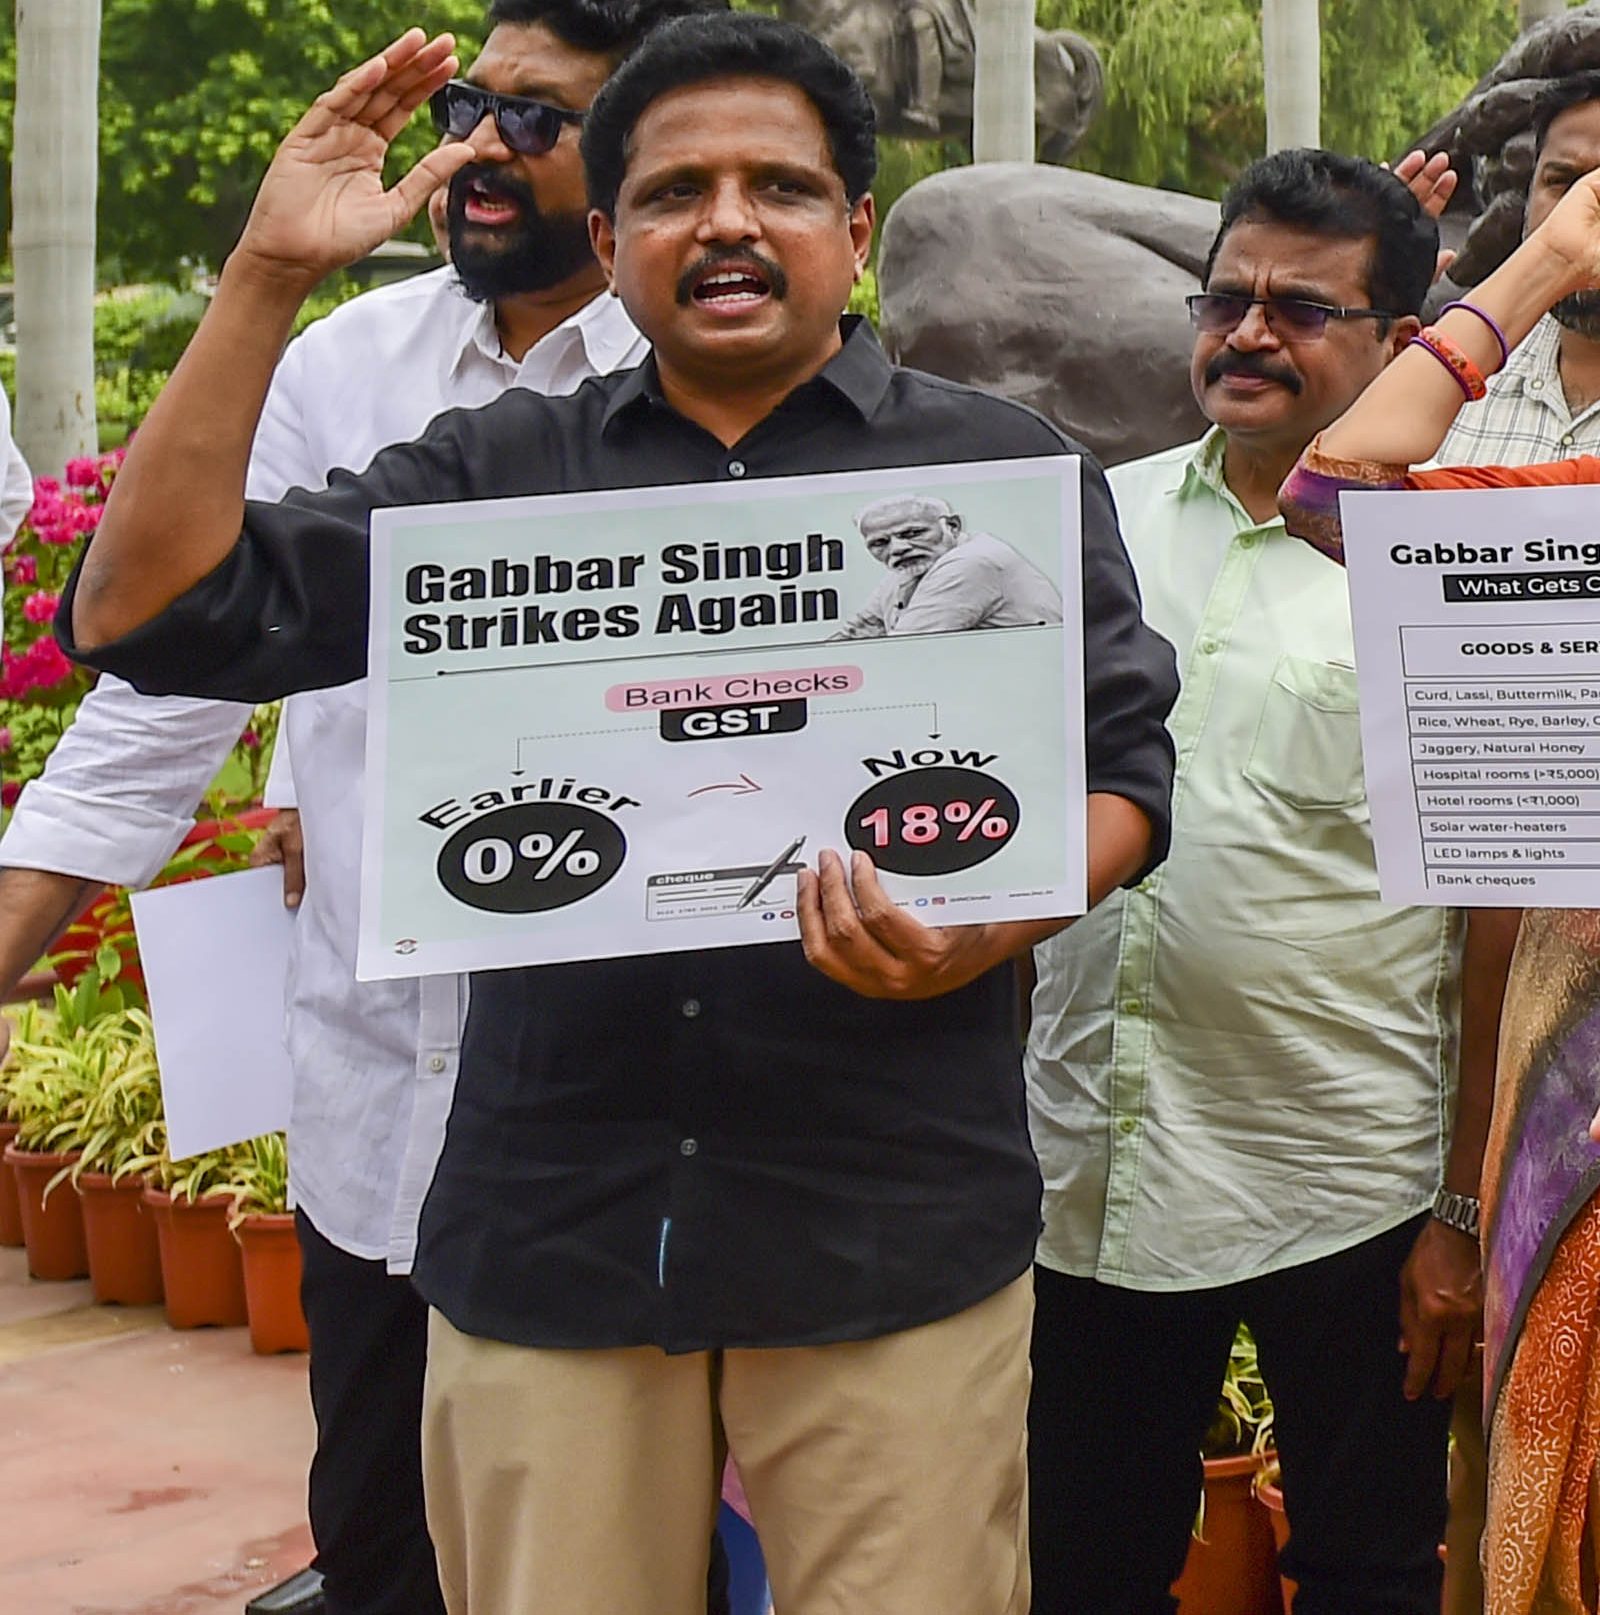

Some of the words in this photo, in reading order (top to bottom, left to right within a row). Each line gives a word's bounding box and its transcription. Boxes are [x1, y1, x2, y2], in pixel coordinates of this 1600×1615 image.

[1390, 543, 1513, 564] Gabbar
[404, 552, 645, 605] Gabbar
[661, 533, 844, 587] Singh
[1458, 578, 1522, 595] What
[1527, 577, 1580, 594] Gets
[403, 600, 639, 656] Strikes
[655, 583, 839, 635] Again
[1461, 642, 1534, 655] GOODS
[1540, 641, 1553, 654] &
[625, 683, 712, 708] Bank
[724, 670, 849, 699] Checks
[1415, 689, 1452, 703] Curd,
[1496, 688, 1577, 702] Buttermilk,
[681, 705, 780, 737] GST
[1418, 716, 1451, 729] Rice,
[1454, 716, 1505, 728] Wheat,
[1509, 716, 1538, 729] Rye,
[1542, 715, 1589, 728] Barley,
[1420, 742, 1480, 756] Jaggery,
[1484, 742, 1536, 753] Natural
[1539, 742, 1585, 755] Honey
[861, 747, 1000, 778] Now
[1423, 768, 1481, 782] Hospital
[1485, 770, 1530, 780] rooms
[419, 778, 641, 831] Earlier
[1427, 795, 1464, 806] Hotel
[1468, 796, 1513, 806] rooms
[859, 798, 1009, 849] 18%
[1430, 821, 1465, 832] Solar
[1468, 821, 1567, 832] water-heaters
[462, 829, 600, 885] 0%
[1433, 848, 1461, 859] LED
[1466, 848, 1508, 860] lamps
[1512, 848, 1521, 859] &
[1525, 847, 1565, 861] lights
[656, 872, 715, 885] cheque
[1437, 874, 1471, 885] Bank
[1476, 874, 1536, 888] cheques
